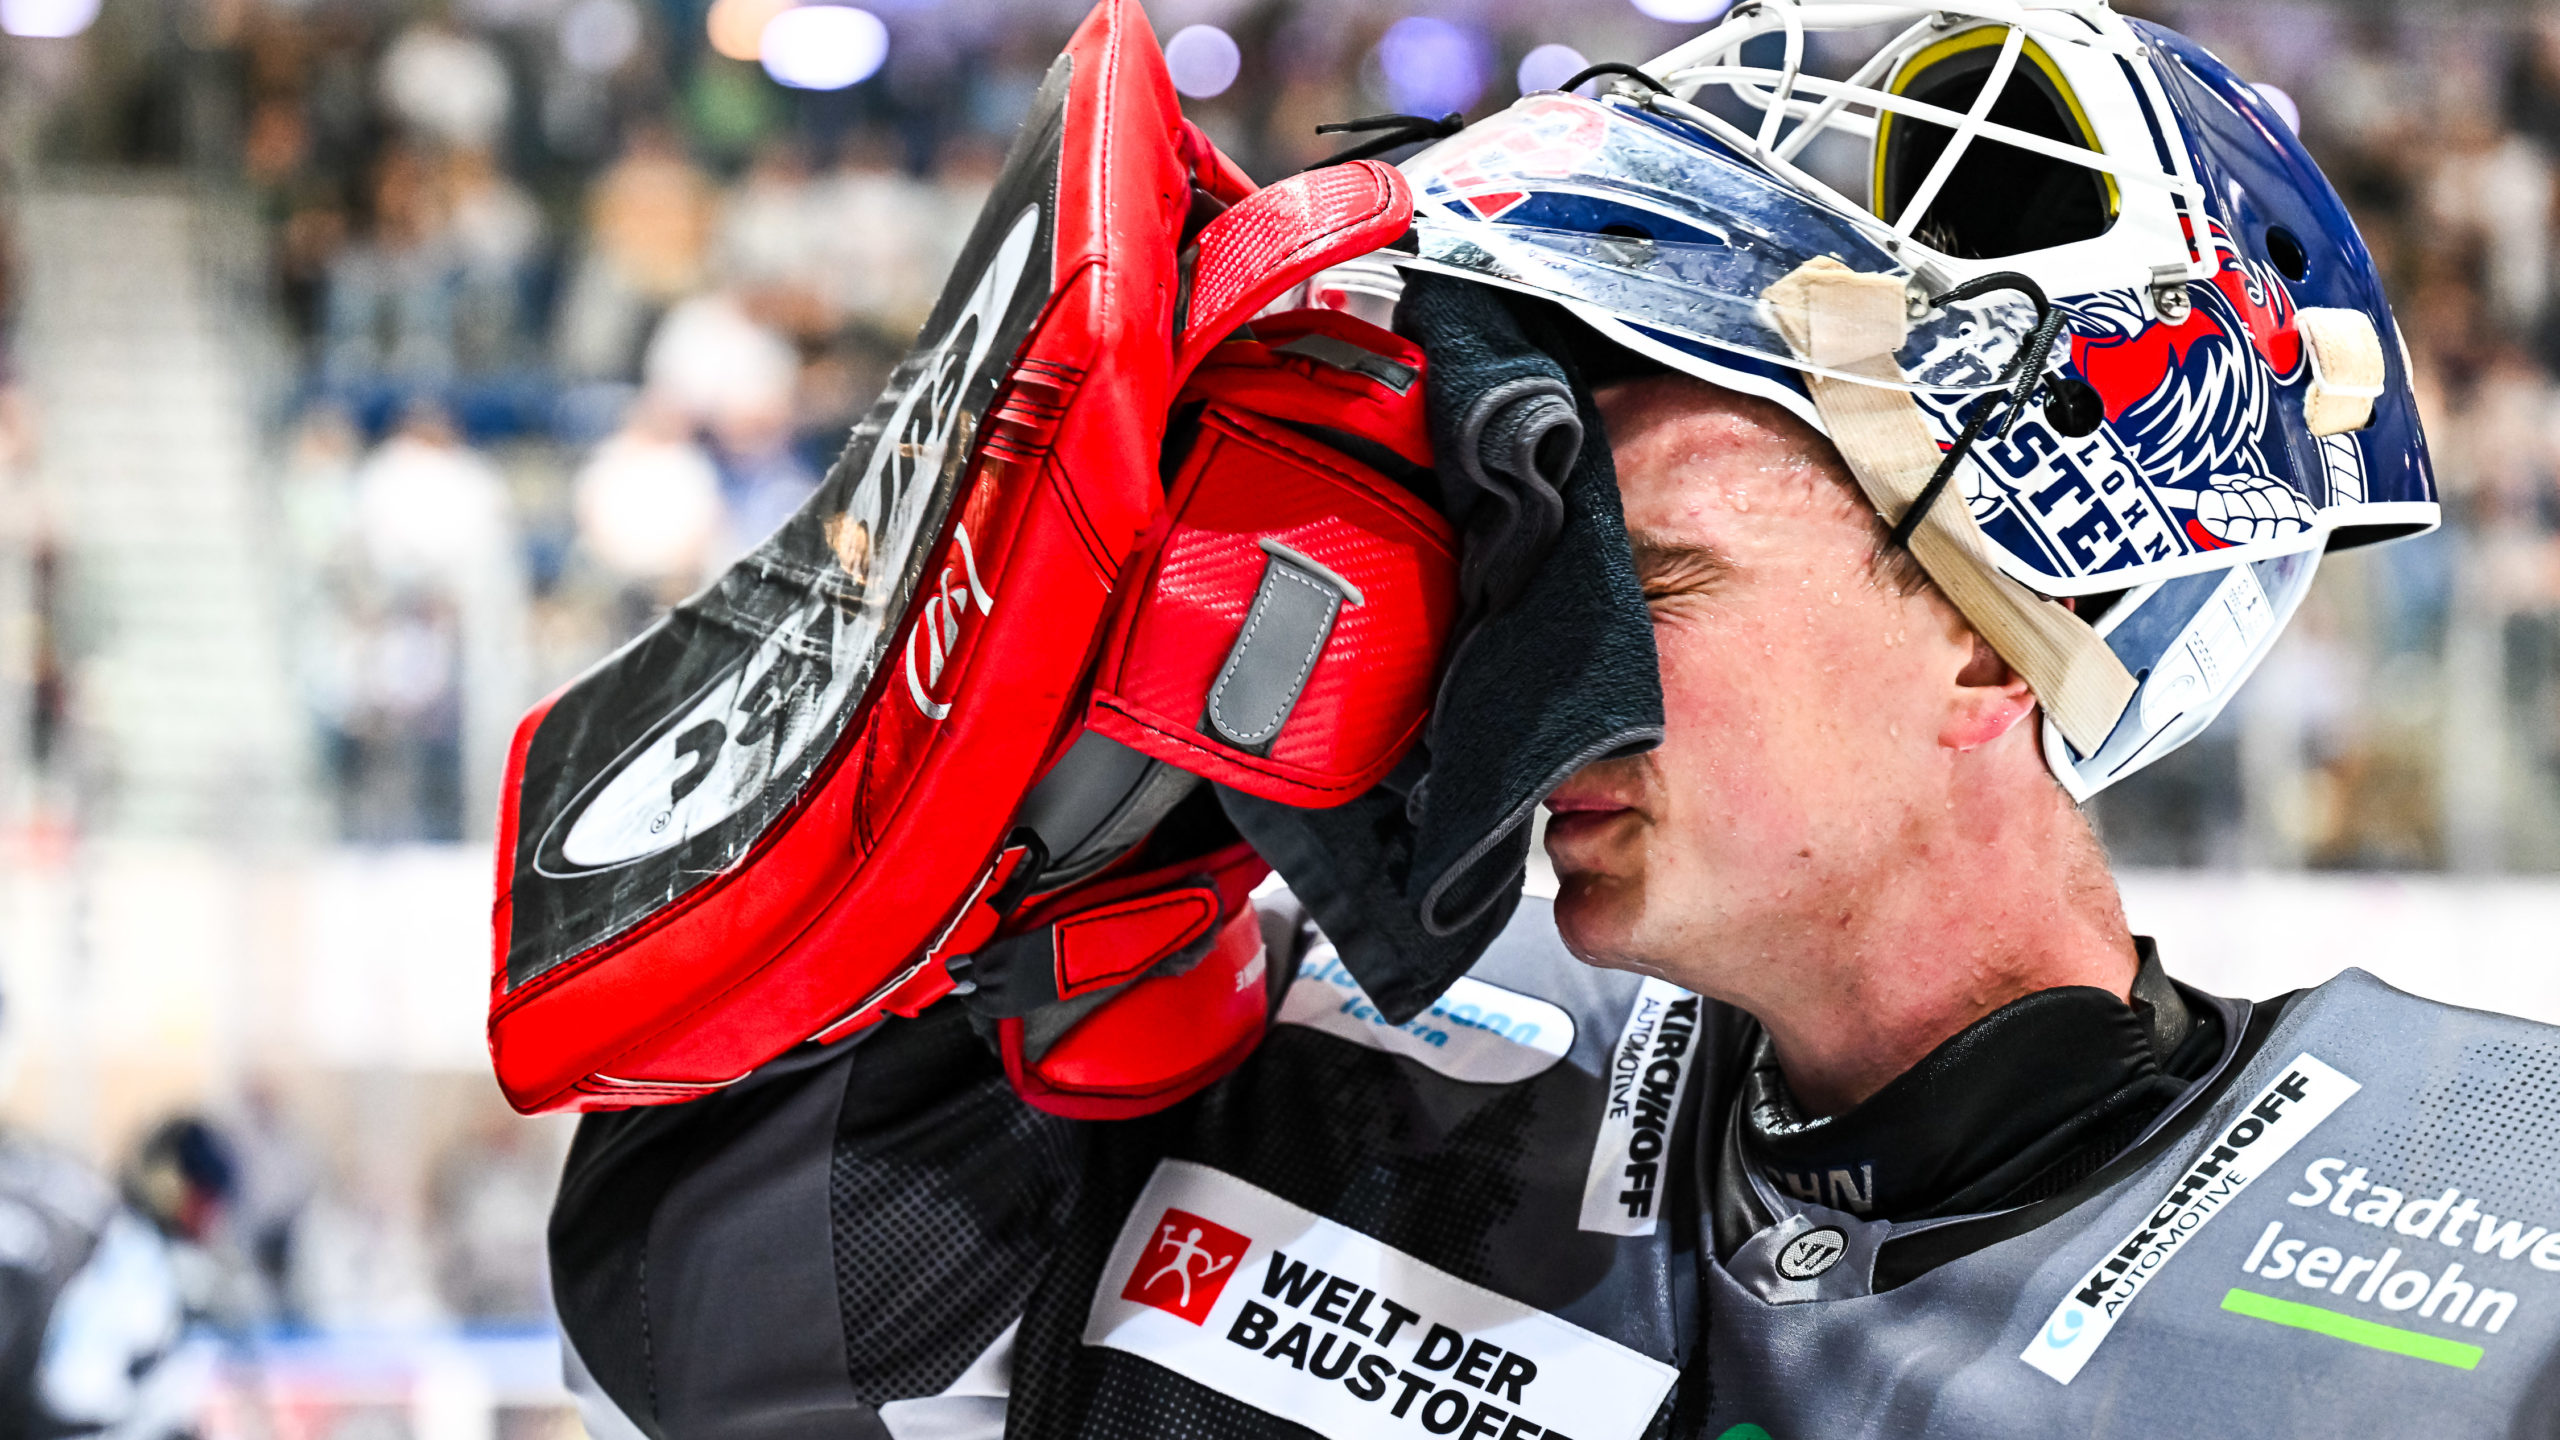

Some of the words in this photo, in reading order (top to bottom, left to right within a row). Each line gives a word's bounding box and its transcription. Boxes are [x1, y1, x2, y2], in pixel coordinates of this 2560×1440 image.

[1608, 997, 1660, 1120] AUTOMOTIVE
[1618, 995, 1699, 1218] KIRCHHOFF
[2075, 1070, 2310, 1309] KIRCHHOFF
[2104, 1169, 2248, 1319] AUTOMOTIVE
[2287, 1157, 2560, 1272] Stadtwe
[1262, 1249, 1421, 1348] WELT
[1412, 1323, 1538, 1406] DER
[2242, 1220, 2518, 1334] Iserlohn
[1226, 1299, 1574, 1440] BAUSTOFF
